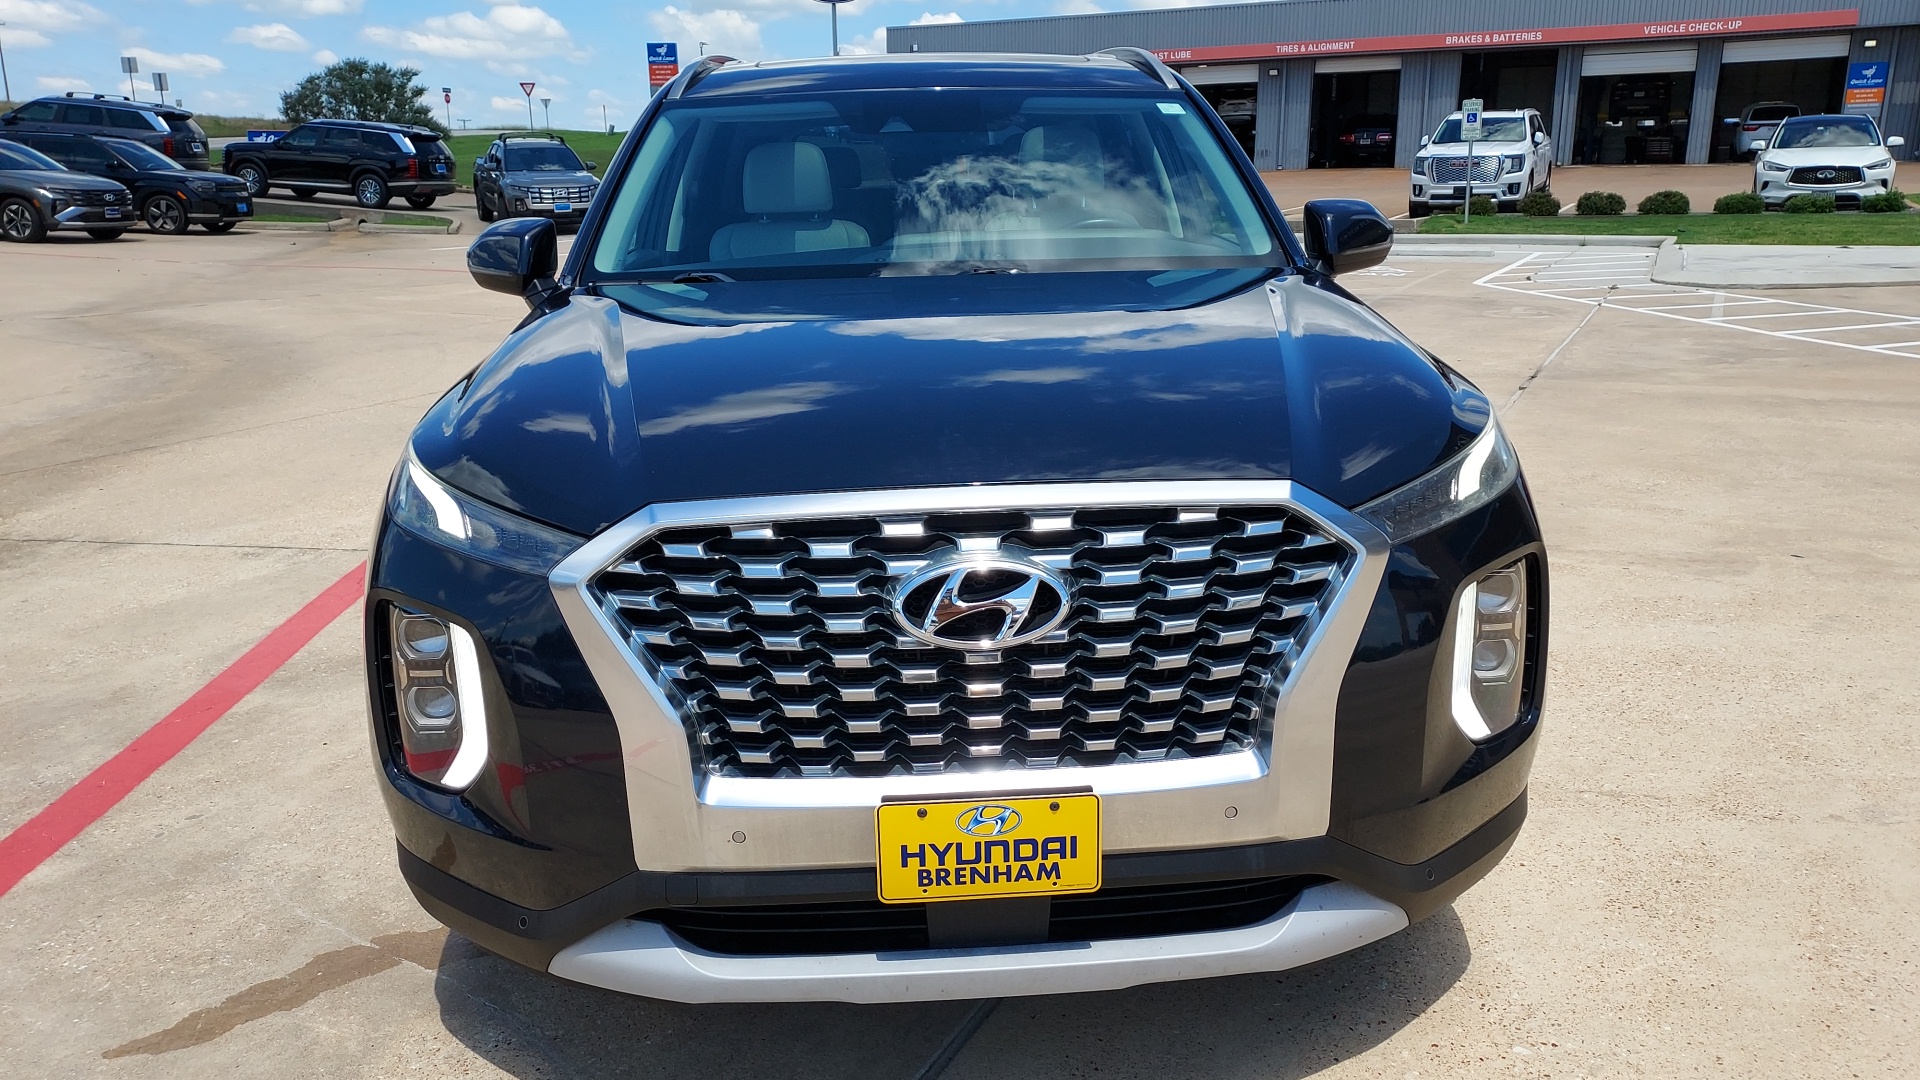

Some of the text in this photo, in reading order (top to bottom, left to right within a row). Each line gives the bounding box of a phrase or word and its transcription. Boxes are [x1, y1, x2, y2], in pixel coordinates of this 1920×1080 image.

[1644, 20, 1743, 35] VEHICLE CHECK-UP
[1445, 31, 1543, 44] BRAKES & BATTERIES
[1276, 45, 1299, 53] TIRES
[1307, 42, 1356, 51] ALIGNMENT
[1170, 51, 1192, 59] LUBE
[901, 835, 1078, 868] HYUNDAI
[917, 861, 1062, 888] BRENHAM
